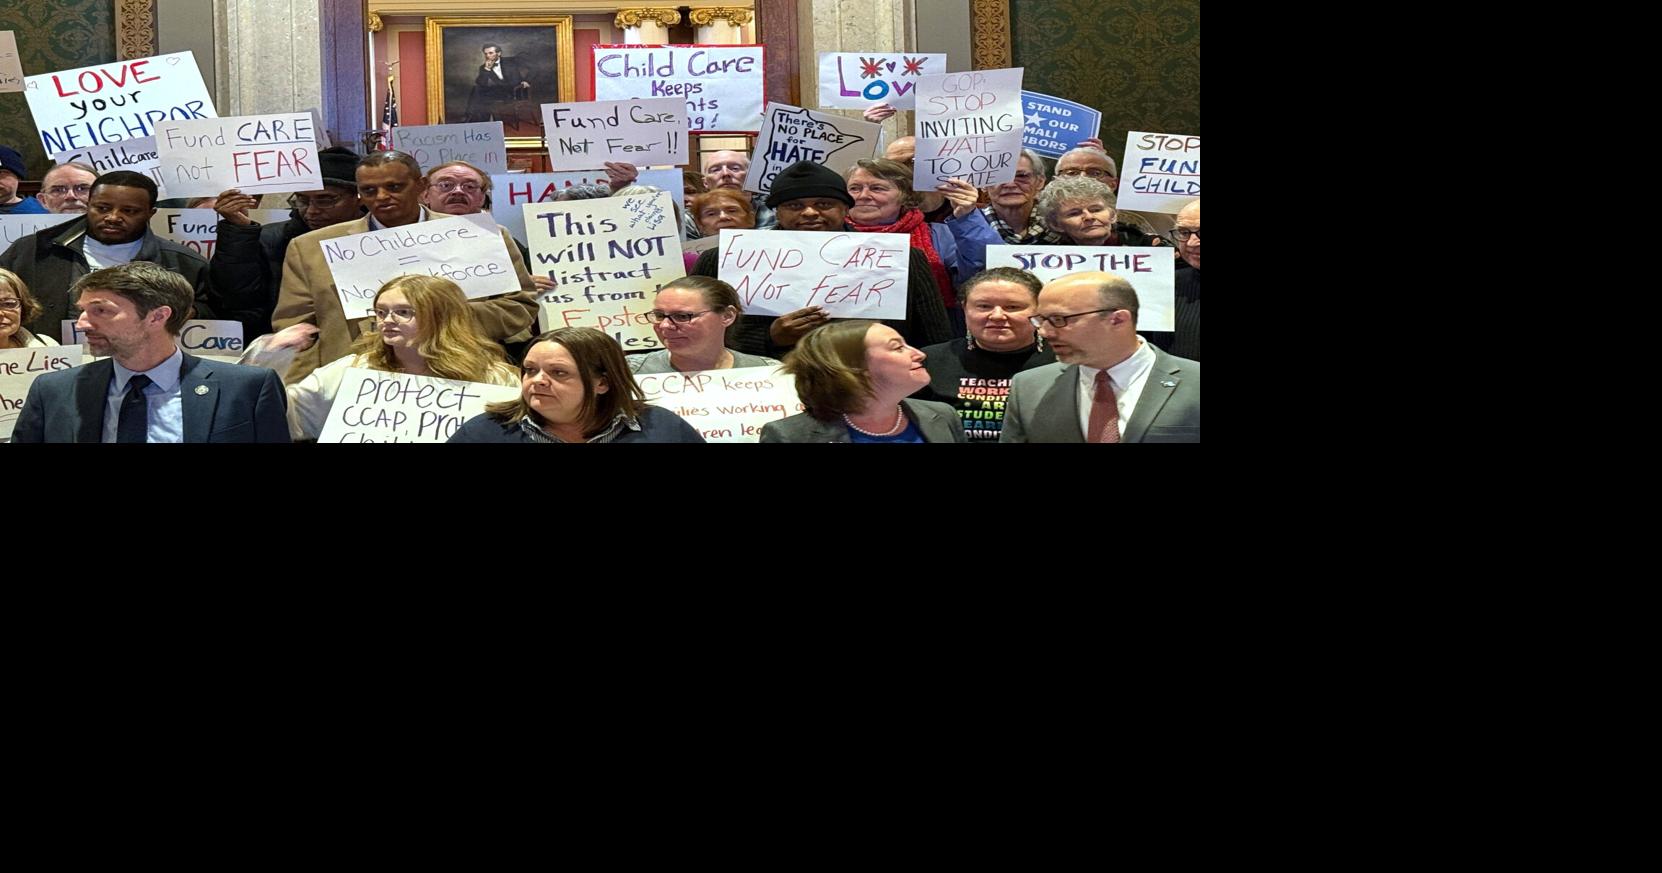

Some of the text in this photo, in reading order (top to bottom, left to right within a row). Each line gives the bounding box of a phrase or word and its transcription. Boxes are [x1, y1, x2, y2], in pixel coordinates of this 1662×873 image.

[597, 51, 755, 78] Child Care
[51, 60, 161, 97] LOVE
[651, 80, 703, 99] Keeps
[70, 90, 141, 120] your
[928, 92, 996, 115] STOP
[1027, 101, 1072, 117] STAND
[553, 106, 619, 129] Fund
[777, 112, 825, 130] There's
[920, 113, 1013, 139] INVITING
[1048, 119, 1080, 132] OUR
[166, 126, 226, 149] Fund
[237, 119, 313, 142] CARE
[464, 129, 492, 144] Has
[777, 124, 844, 144] NO PLACE
[787, 136, 807, 145] for
[1024, 126, 1058, 139] MALI
[560, 137, 593, 156] Not
[606, 137, 662, 155] Fear
[770, 141, 825, 163] HATE
[937, 135, 1000, 157] HATE
[1136, 135, 1201, 153] STOP
[175, 156, 214, 184] not
[232, 148, 313, 183] FEAR
[923, 152, 1012, 174] TO OUR
[537, 212, 617, 239] This
[325, 227, 478, 263] No Childcare
[537, 242, 595, 265] will
[608, 234, 674, 259] NOT
[721, 234, 903, 271] FUND CARE
[1012, 253, 1152, 273] STOP THE
[544, 293, 574, 304] us
[583, 285, 646, 303] from
[735, 272, 895, 307] NOT FEAR
[181, 325, 242, 351] Care
[26, 351, 73, 373] Lies
[640, 375, 774, 396] CCAP keeps
[959, 387, 1010, 395] WORK
[957, 410, 1004, 420] STUDE
[981, 401, 1007, 409] AR
